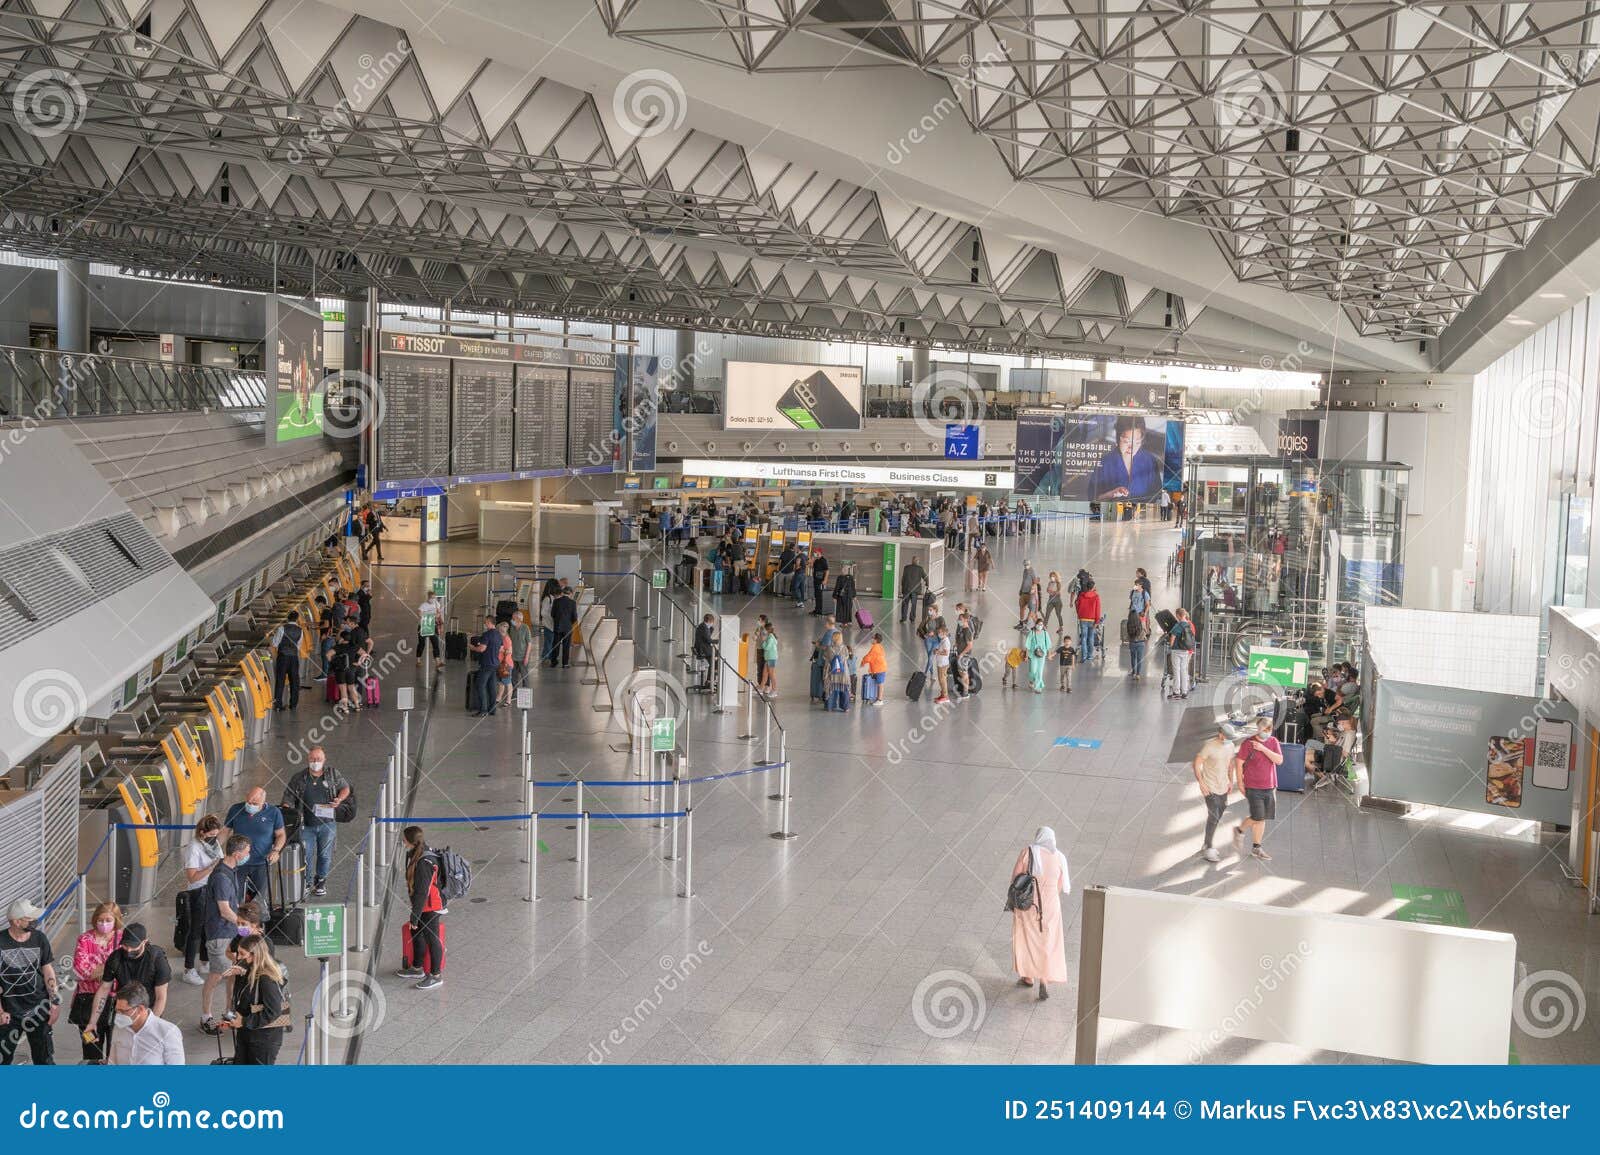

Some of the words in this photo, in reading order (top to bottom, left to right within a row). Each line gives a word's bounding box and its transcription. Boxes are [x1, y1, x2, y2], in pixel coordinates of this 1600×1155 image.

[405, 336, 445, 353] TISSOT
[585, 353, 611, 366] TISSOT
[948, 443, 967, 457] A,Z
[1066, 443, 1112, 451] IMPOSSIBLE
[1040, 450, 1062, 458] FUTU
[772, 465, 817, 478] Lufthansa
[819, 468, 838, 478] First
[840, 469, 866, 480] Class
[889, 471, 930, 482] Business
[932, 473, 959, 483] Class
